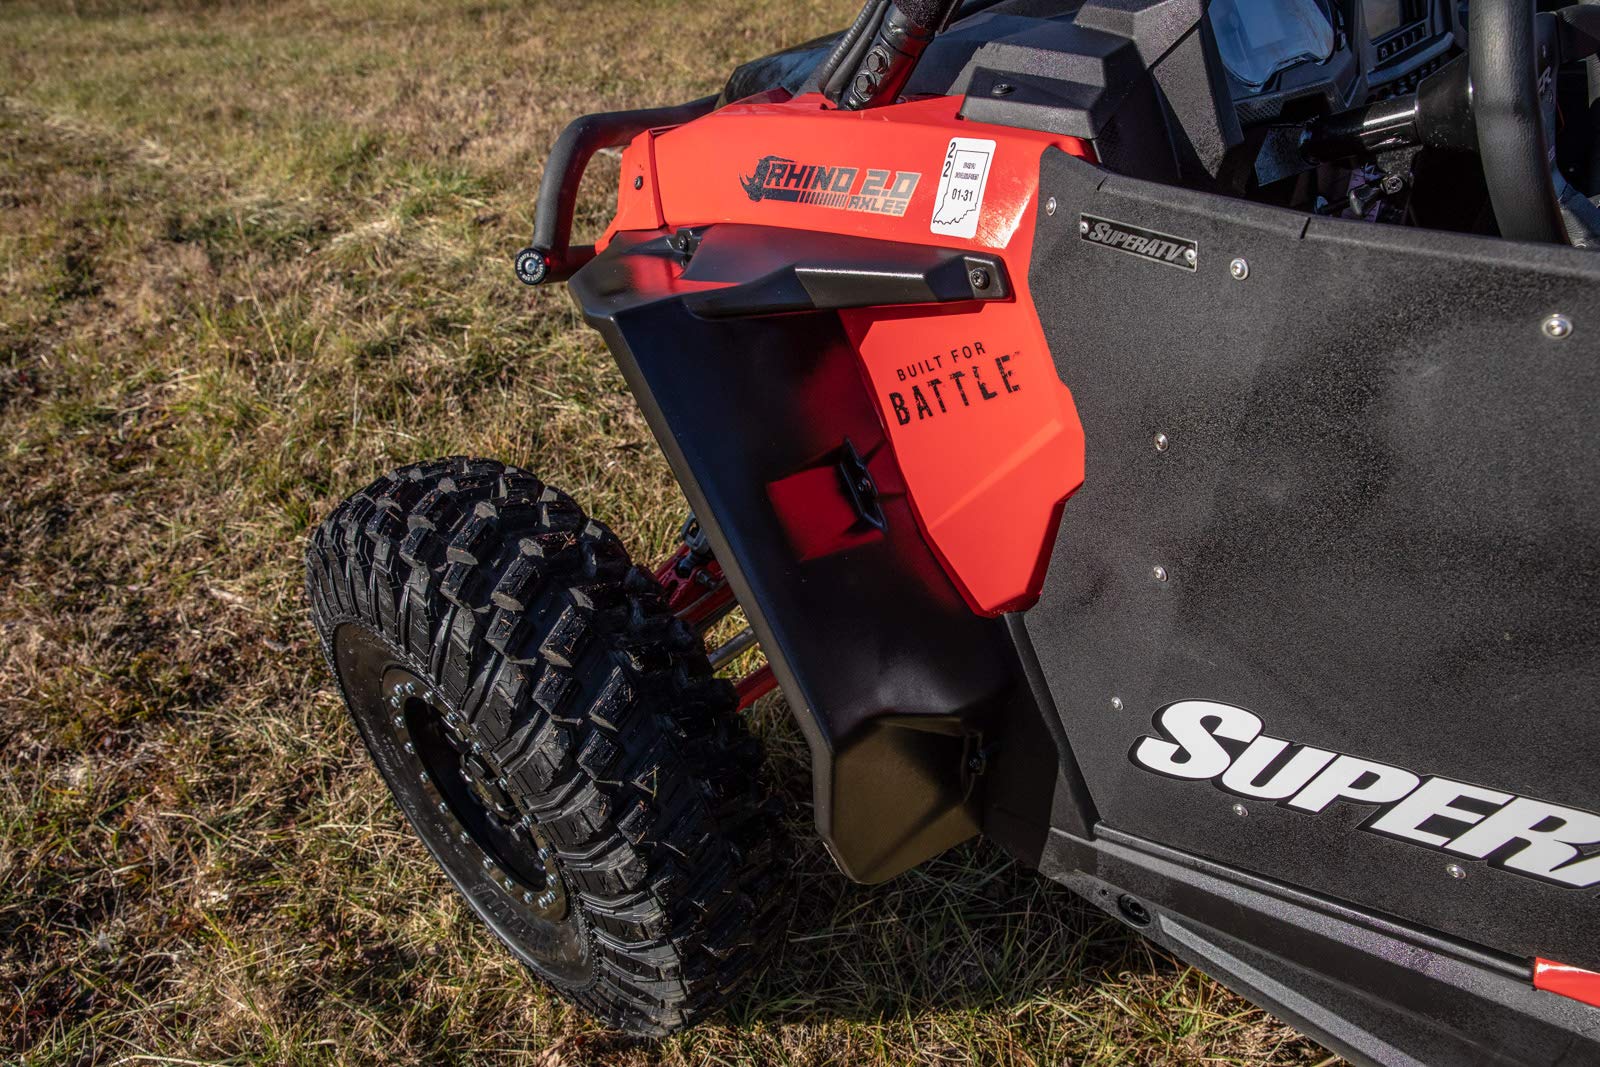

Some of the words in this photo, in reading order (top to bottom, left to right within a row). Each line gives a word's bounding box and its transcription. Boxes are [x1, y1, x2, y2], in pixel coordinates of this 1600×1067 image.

[948, 142, 956, 158] 2
[943, 161, 951, 177] 2
[766, 163, 858, 192] RHINO
[860, 169, 921, 199] 2.0
[952, 188, 973, 201] 01-31
[848, 195, 907, 215] AXLES
[896, 355, 942, 381] BUILT
[950, 341, 986, 363] FOR
[889, 354, 1020, 426] BATTLE
